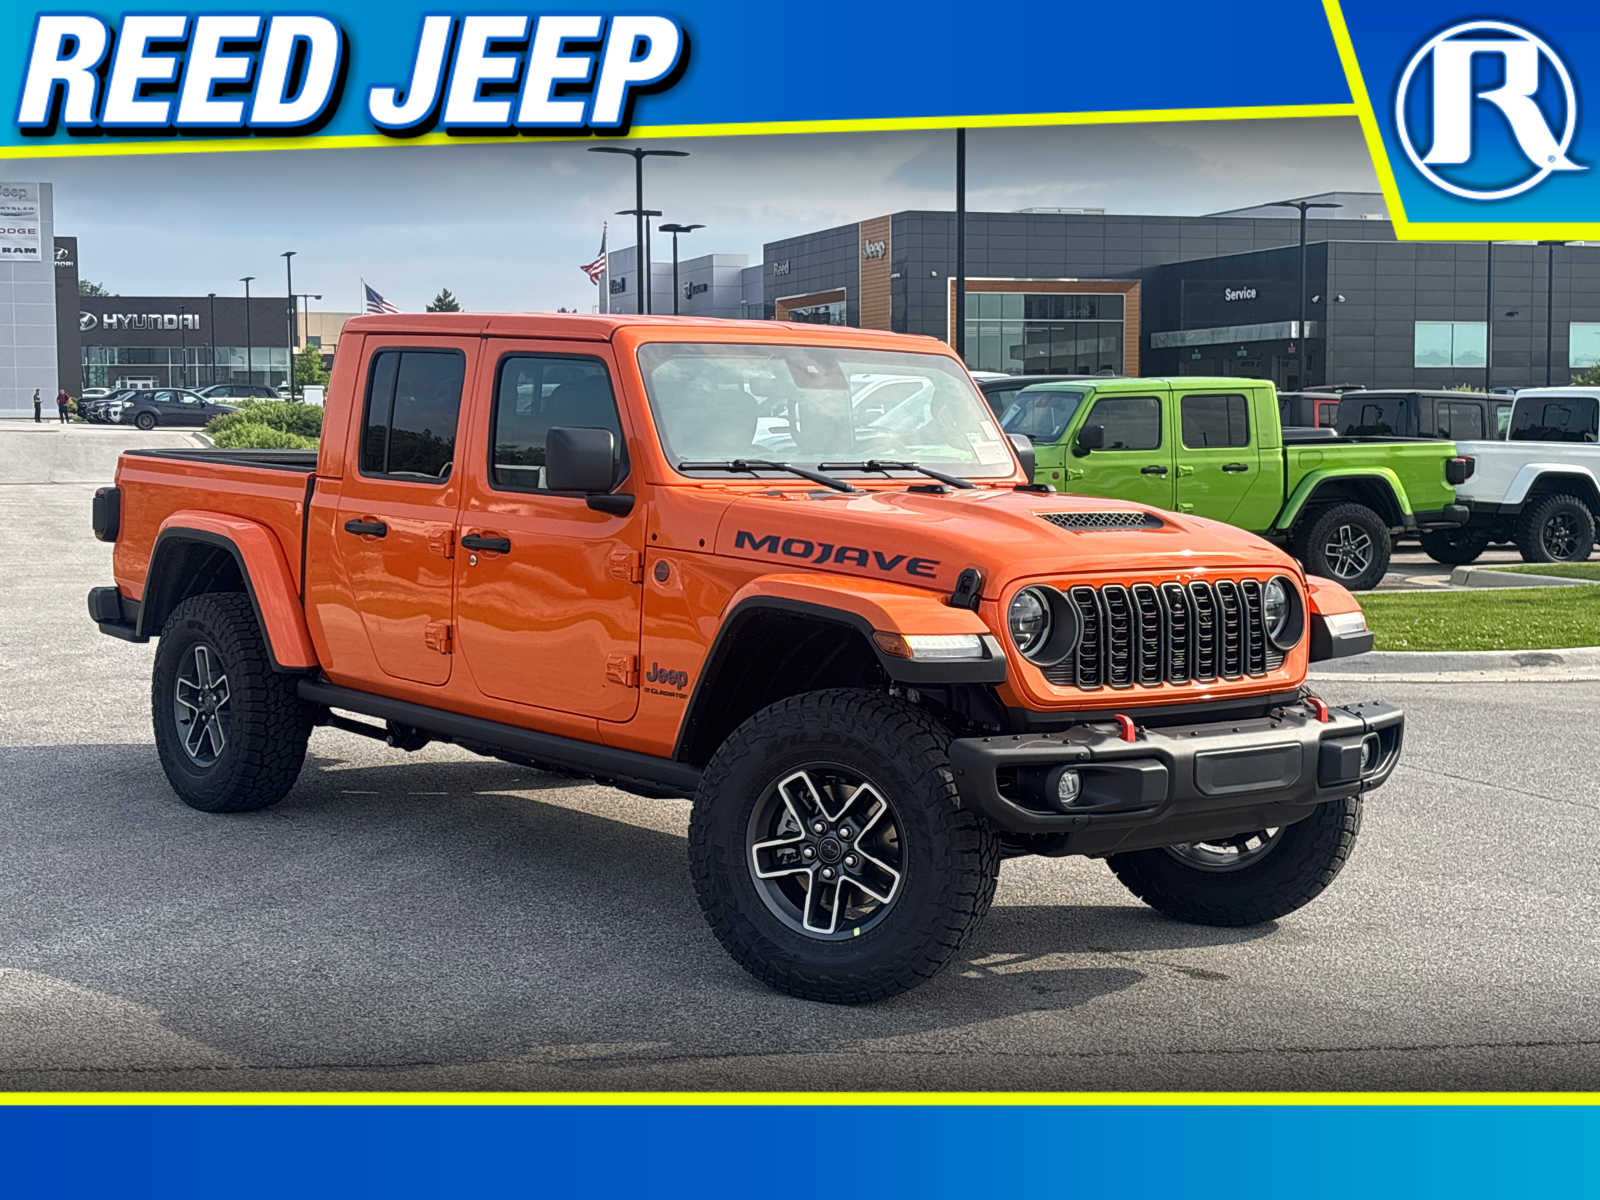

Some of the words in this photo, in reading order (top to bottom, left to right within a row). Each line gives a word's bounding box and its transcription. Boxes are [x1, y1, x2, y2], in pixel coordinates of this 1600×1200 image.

[0, 185, 27, 200] eep
[863, 240, 886, 260] Jeep
[1225, 287, 1257, 300] Service
[103, 314, 199, 330] HYUNDAI
[735, 530, 940, 578] MOJAVE
[646, 662, 688, 690] Jeep
